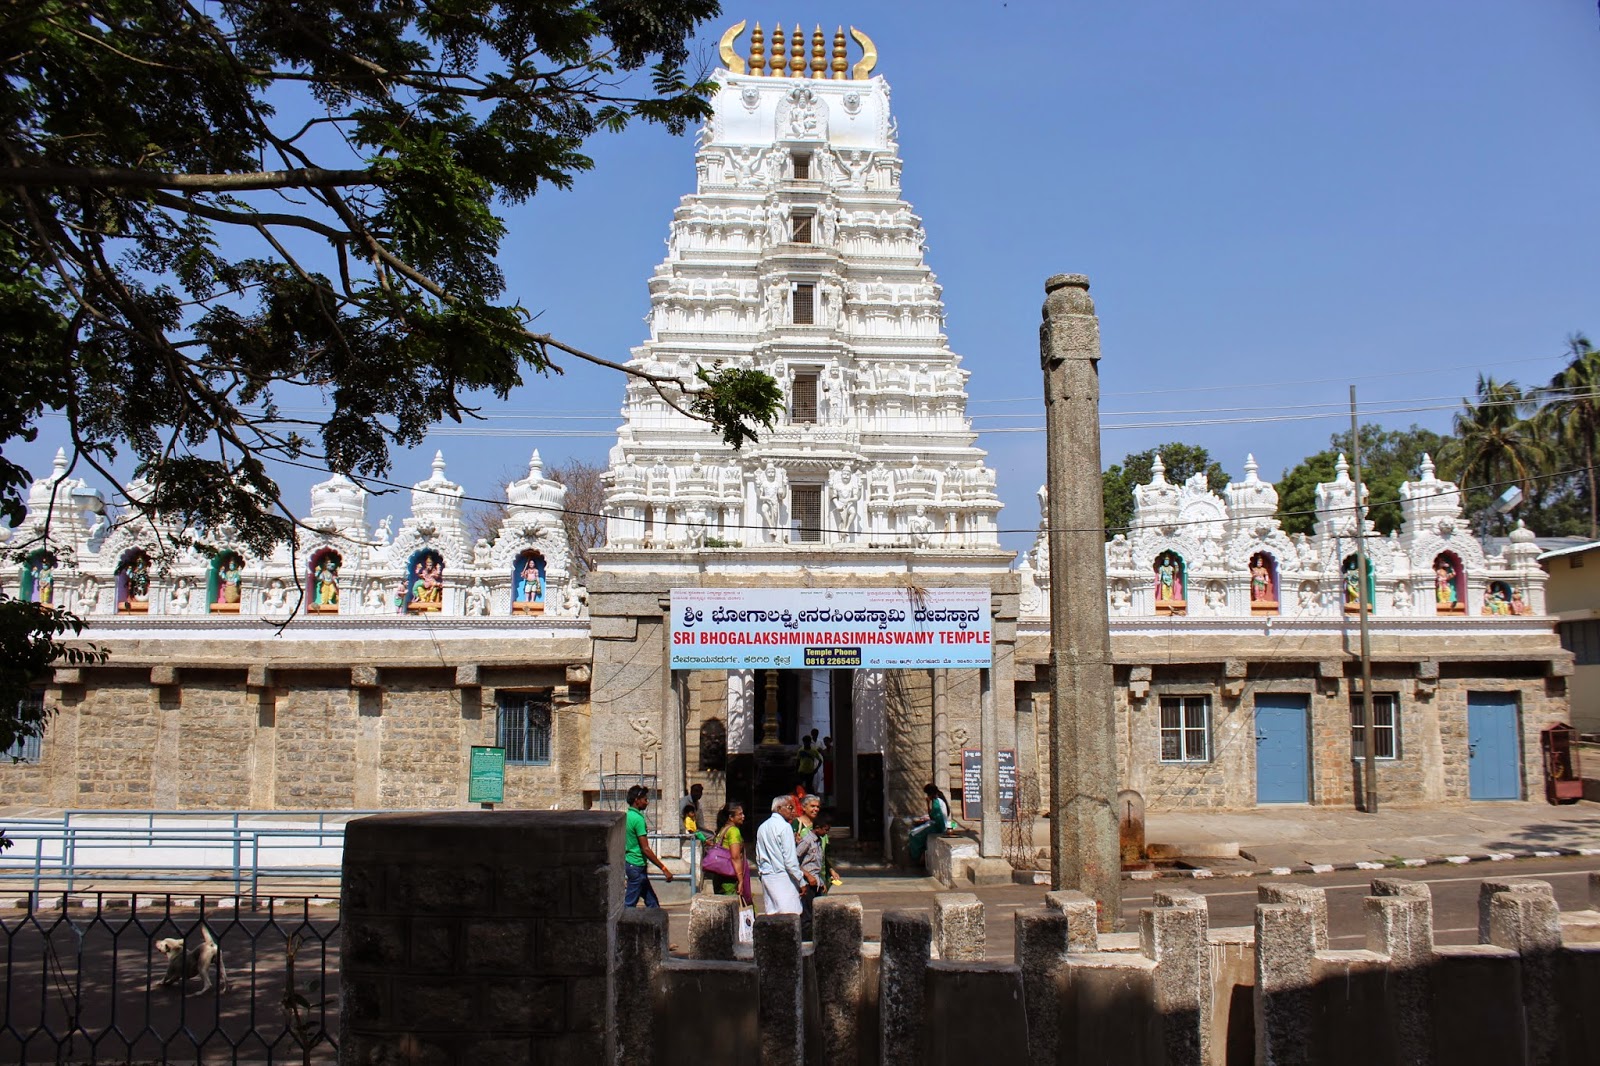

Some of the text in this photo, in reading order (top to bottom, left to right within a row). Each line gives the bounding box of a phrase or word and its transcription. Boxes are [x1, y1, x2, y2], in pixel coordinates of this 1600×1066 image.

[683, 606, 703, 627] ಶ್ರೀ
[914, 606, 980, 630] ದೇವಸ್ಥಾನ
[673, 631, 990, 645] SRI BHOGALAKSHMINARASIMHASWAMY TEMPLE
[806, 648, 857, 656] Temple Phone
[806, 657, 860, 665] 0816 2265455
